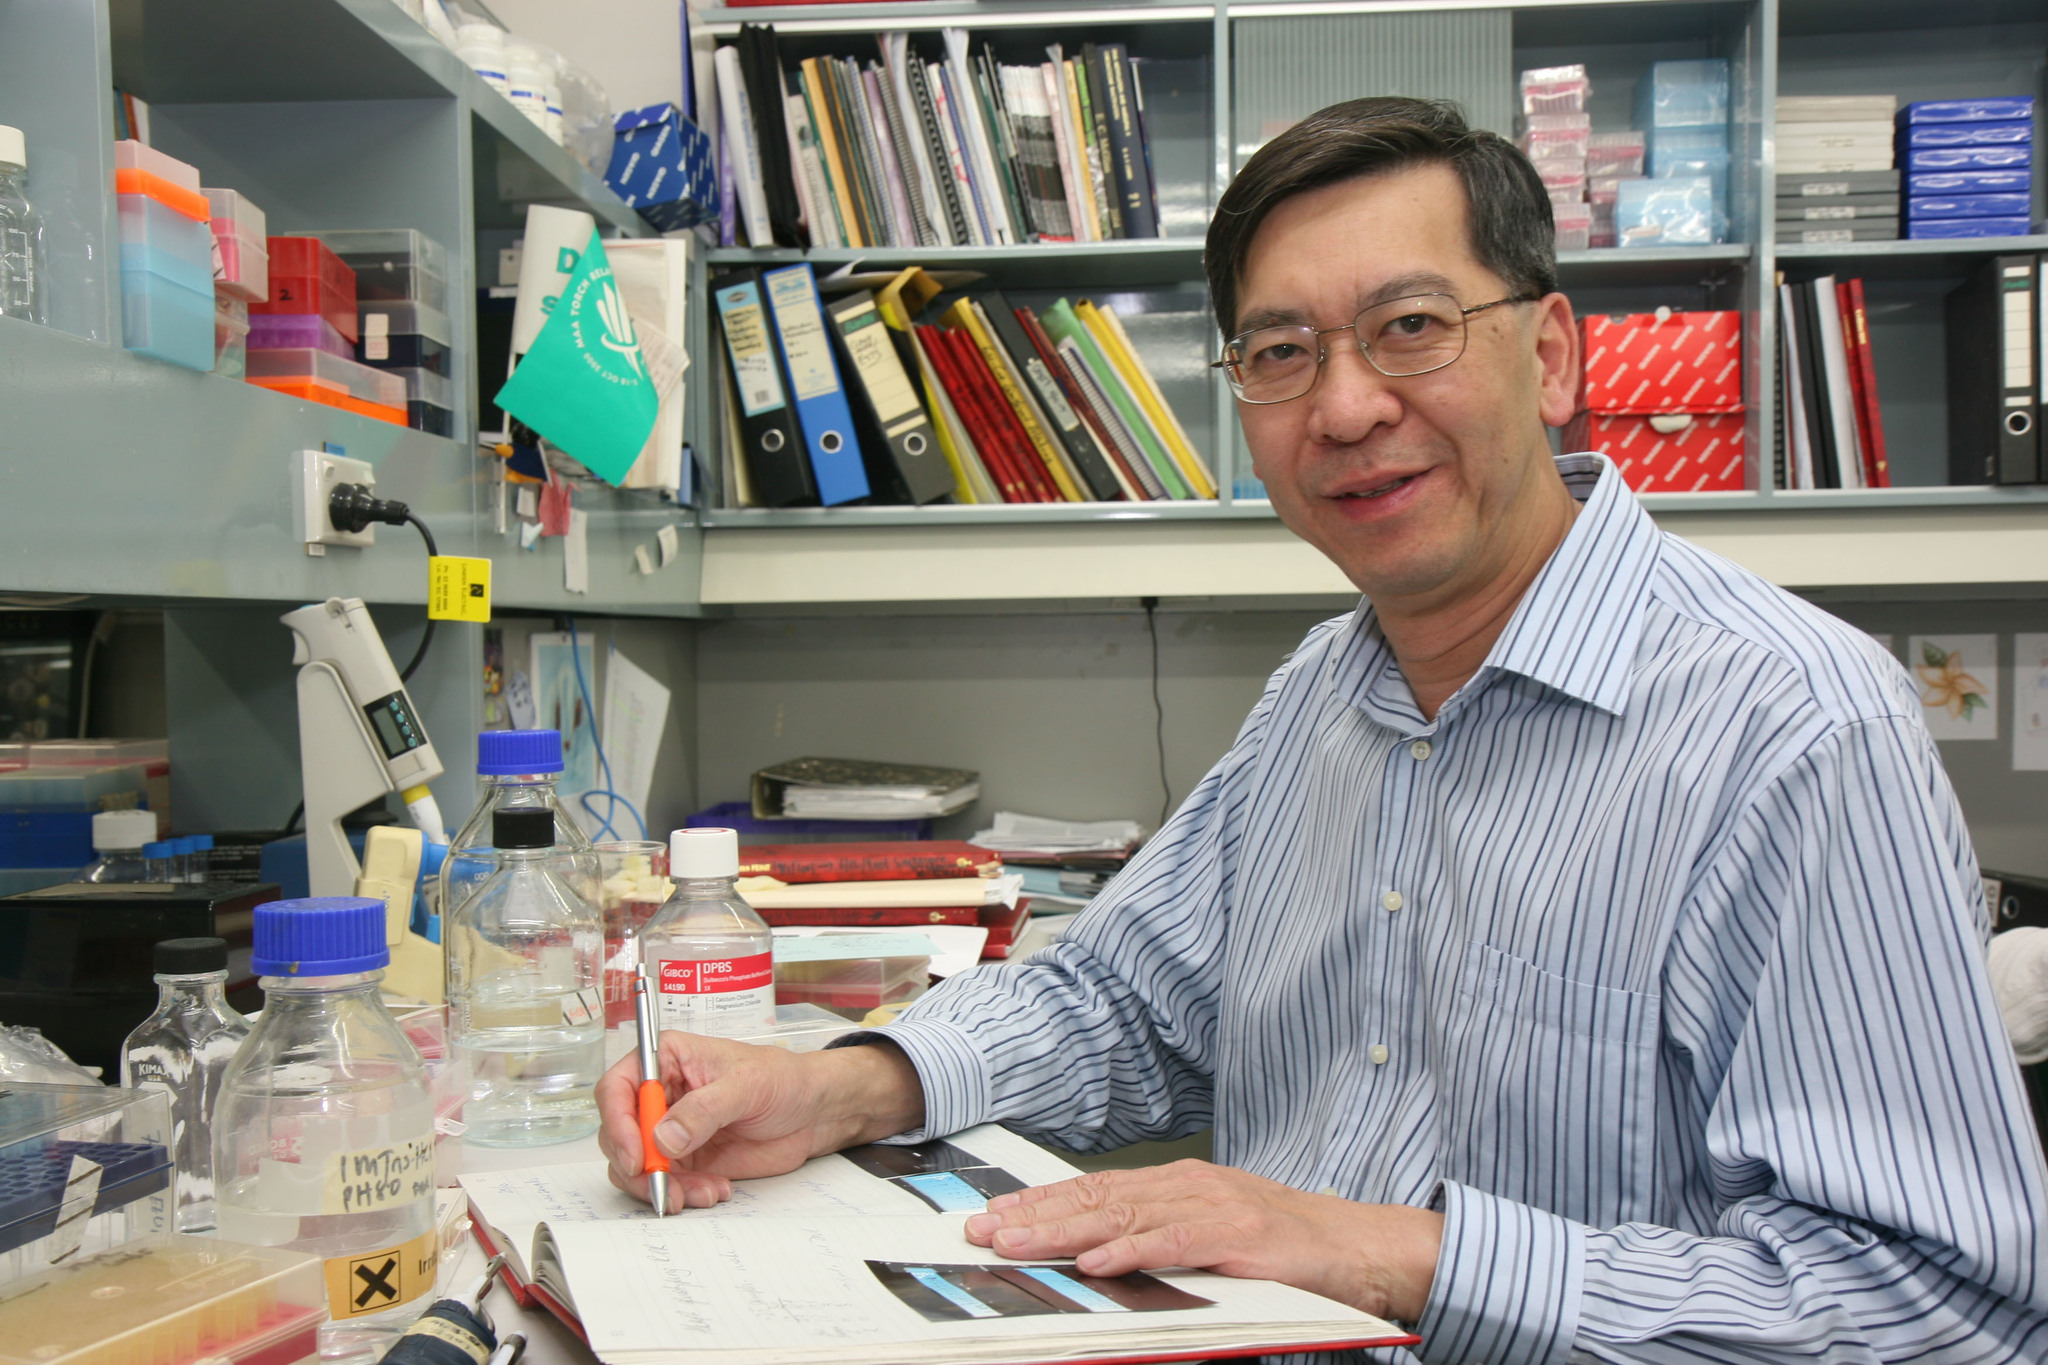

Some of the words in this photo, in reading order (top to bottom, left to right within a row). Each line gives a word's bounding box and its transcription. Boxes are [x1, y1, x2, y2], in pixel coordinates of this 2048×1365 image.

[570, 278, 590, 316] TORCH
[703, 961, 732, 974] DPBS
[664, 983, 686, 991] 14190
